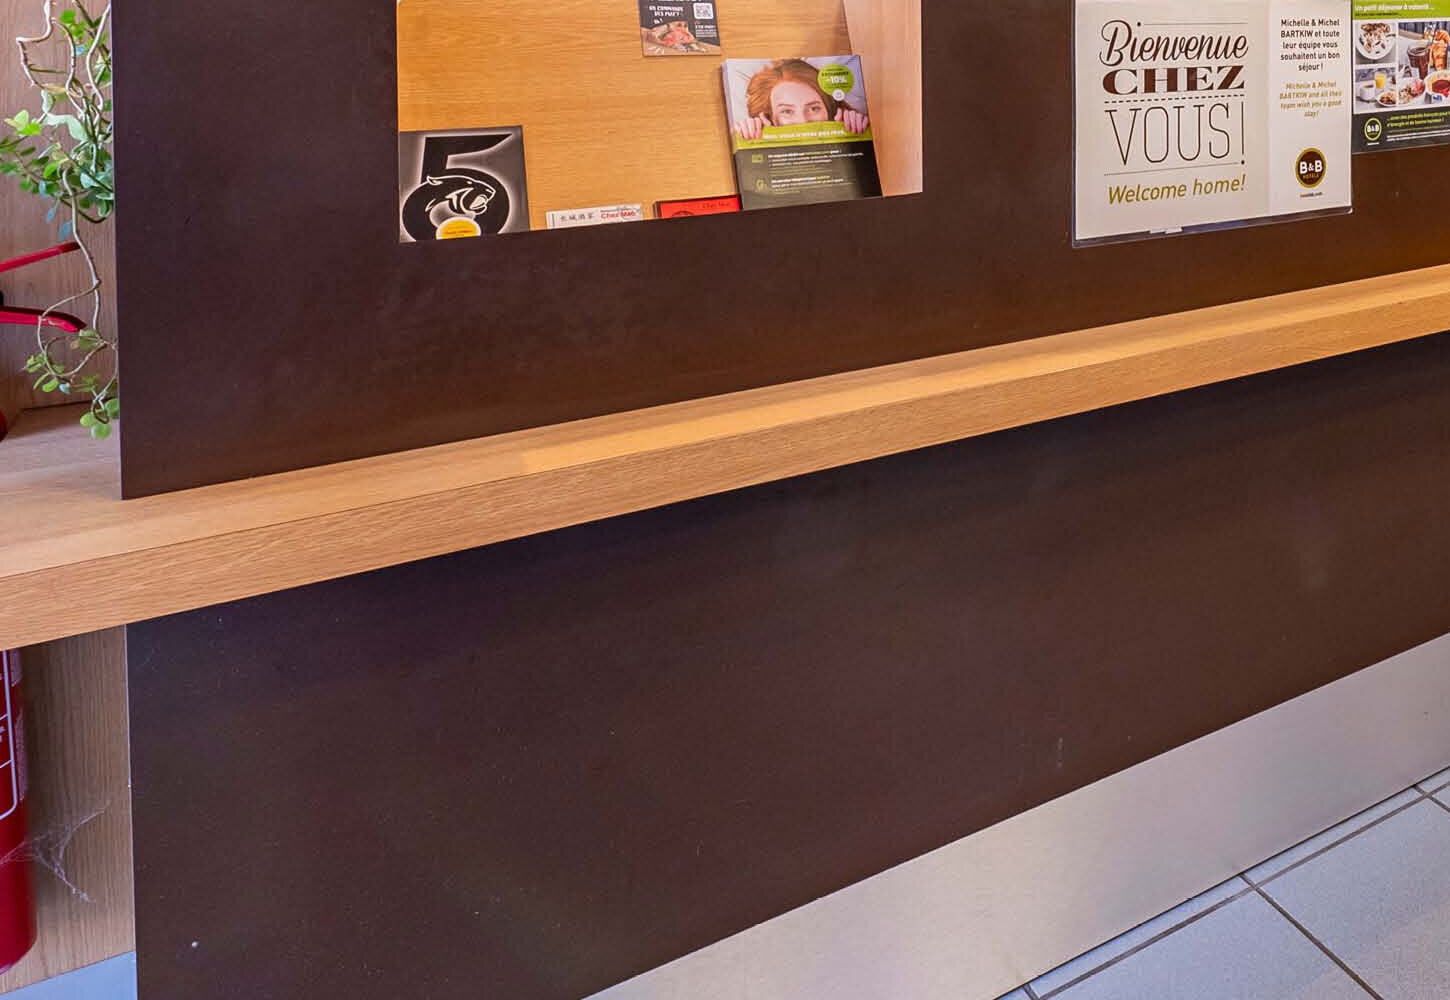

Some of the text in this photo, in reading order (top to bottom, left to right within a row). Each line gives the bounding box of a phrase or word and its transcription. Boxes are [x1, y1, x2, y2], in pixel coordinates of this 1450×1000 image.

[1280, 18, 1340, 27] Michelle & Michel
[1323, 30, 1340, 38] toute
[1099, 19, 1249, 67] Bienvenue
[1282, 41, 1297, 49] leur
[1280, 52, 1317, 61] souhaitent
[1328, 51, 1341, 59] bon
[1102, 64, 1246, 96] CHEZ
[1300, 160, 1323, 174] B&B
[1108, 174, 1246, 206] Welcome home!
